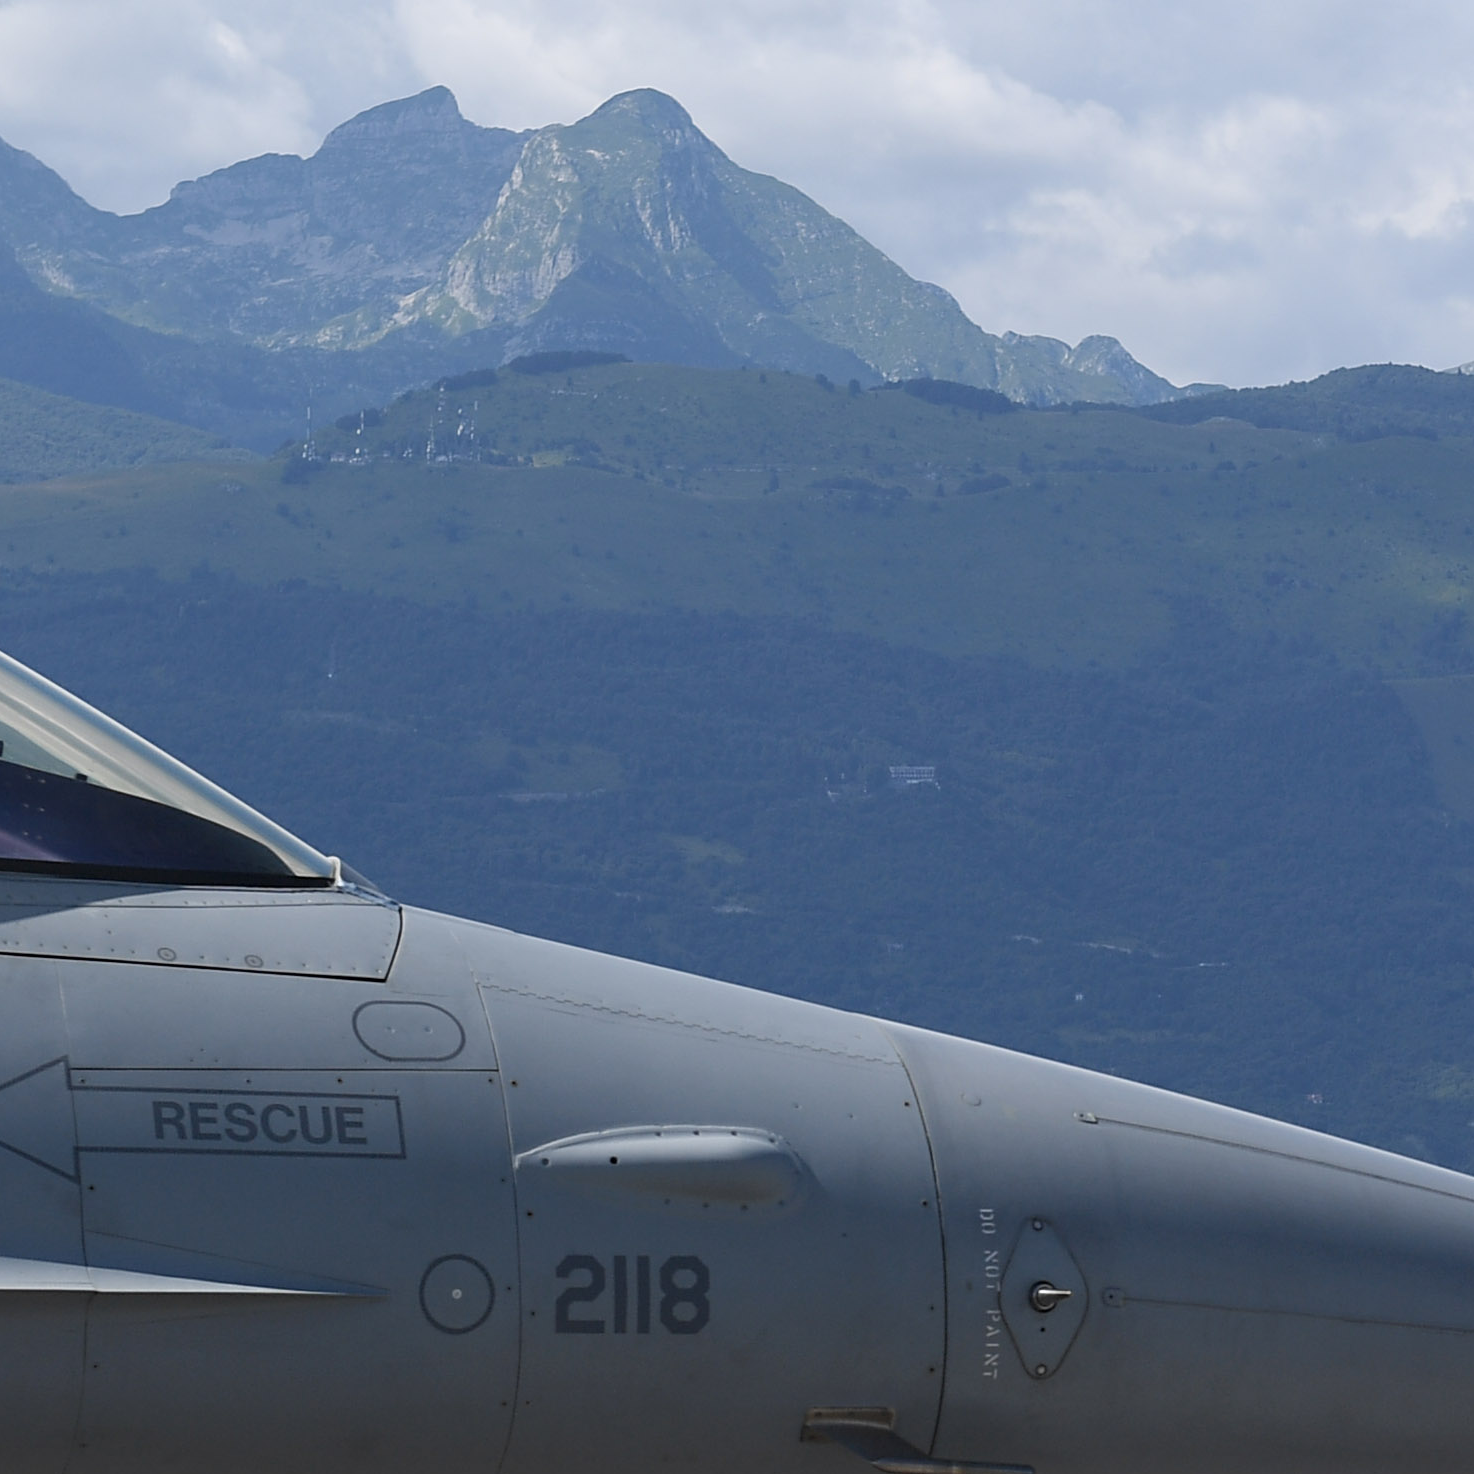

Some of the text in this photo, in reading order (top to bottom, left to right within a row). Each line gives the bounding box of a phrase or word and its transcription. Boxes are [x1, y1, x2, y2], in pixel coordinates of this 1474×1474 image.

[152, 1101, 368, 1145] RESCUE
[555, 1254, 711, 1335] 2118
[979, 1208, 1002, 1380] DO NOT PAINT
